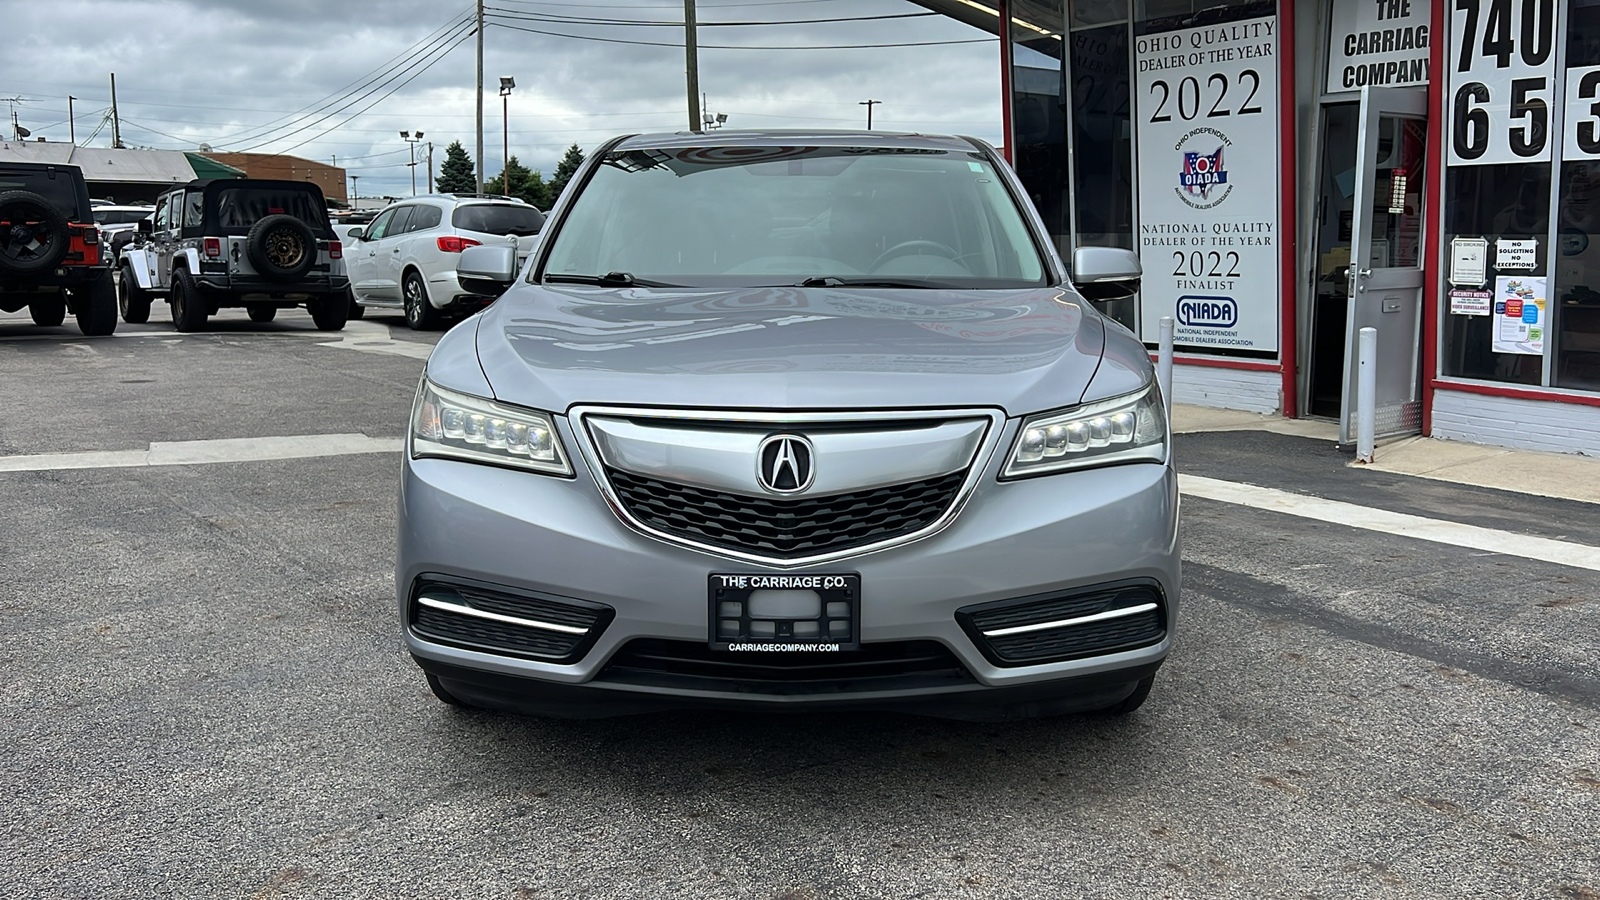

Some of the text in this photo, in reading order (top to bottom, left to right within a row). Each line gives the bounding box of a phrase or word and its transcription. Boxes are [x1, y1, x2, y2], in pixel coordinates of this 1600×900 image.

[1376, 0, 1411, 21] THE
[1137, 20, 1275, 54] OHIO QUALITY
[1343, 24, 1431, 57] CARRIAG
[1455, 0, 1552, 73] 740
[1139, 54, 1186, 73] DEALER
[1188, 52, 1206, 66] OF
[1208, 48, 1234, 64] THE
[1236, 43, 1273, 59] YEAR
[1149, 69, 1262, 123] 2022
[1174, 127, 1233, 151] OHIO INDEPENDENT
[1185, 172, 1220, 185] OIADA
[1174, 187, 1194, 209] AUTOMOBILE
[1212, 184, 1234, 208] ASSOCIATION
[1142, 222, 1273, 235] NATIONAL QUALITY
[1143, 236, 1272, 246] DEALER OF THE YEAR
[1172, 250, 1241, 278] 2022
[1176, 280, 1235, 290] FINALIST
[1452, 290, 1473, 298] SECURITY
[1181, 302, 1232, 321] NIADA
[1172, 335, 1254, 346] OMOBILE DEALERS ASSOCIATION
[1203, 329, 1238, 337] INDEPENDENT
[720, 576, 848, 588] THE CARRIAGE CO.
[728, 643, 840, 652] CARRIAGECOMPANY.COM
